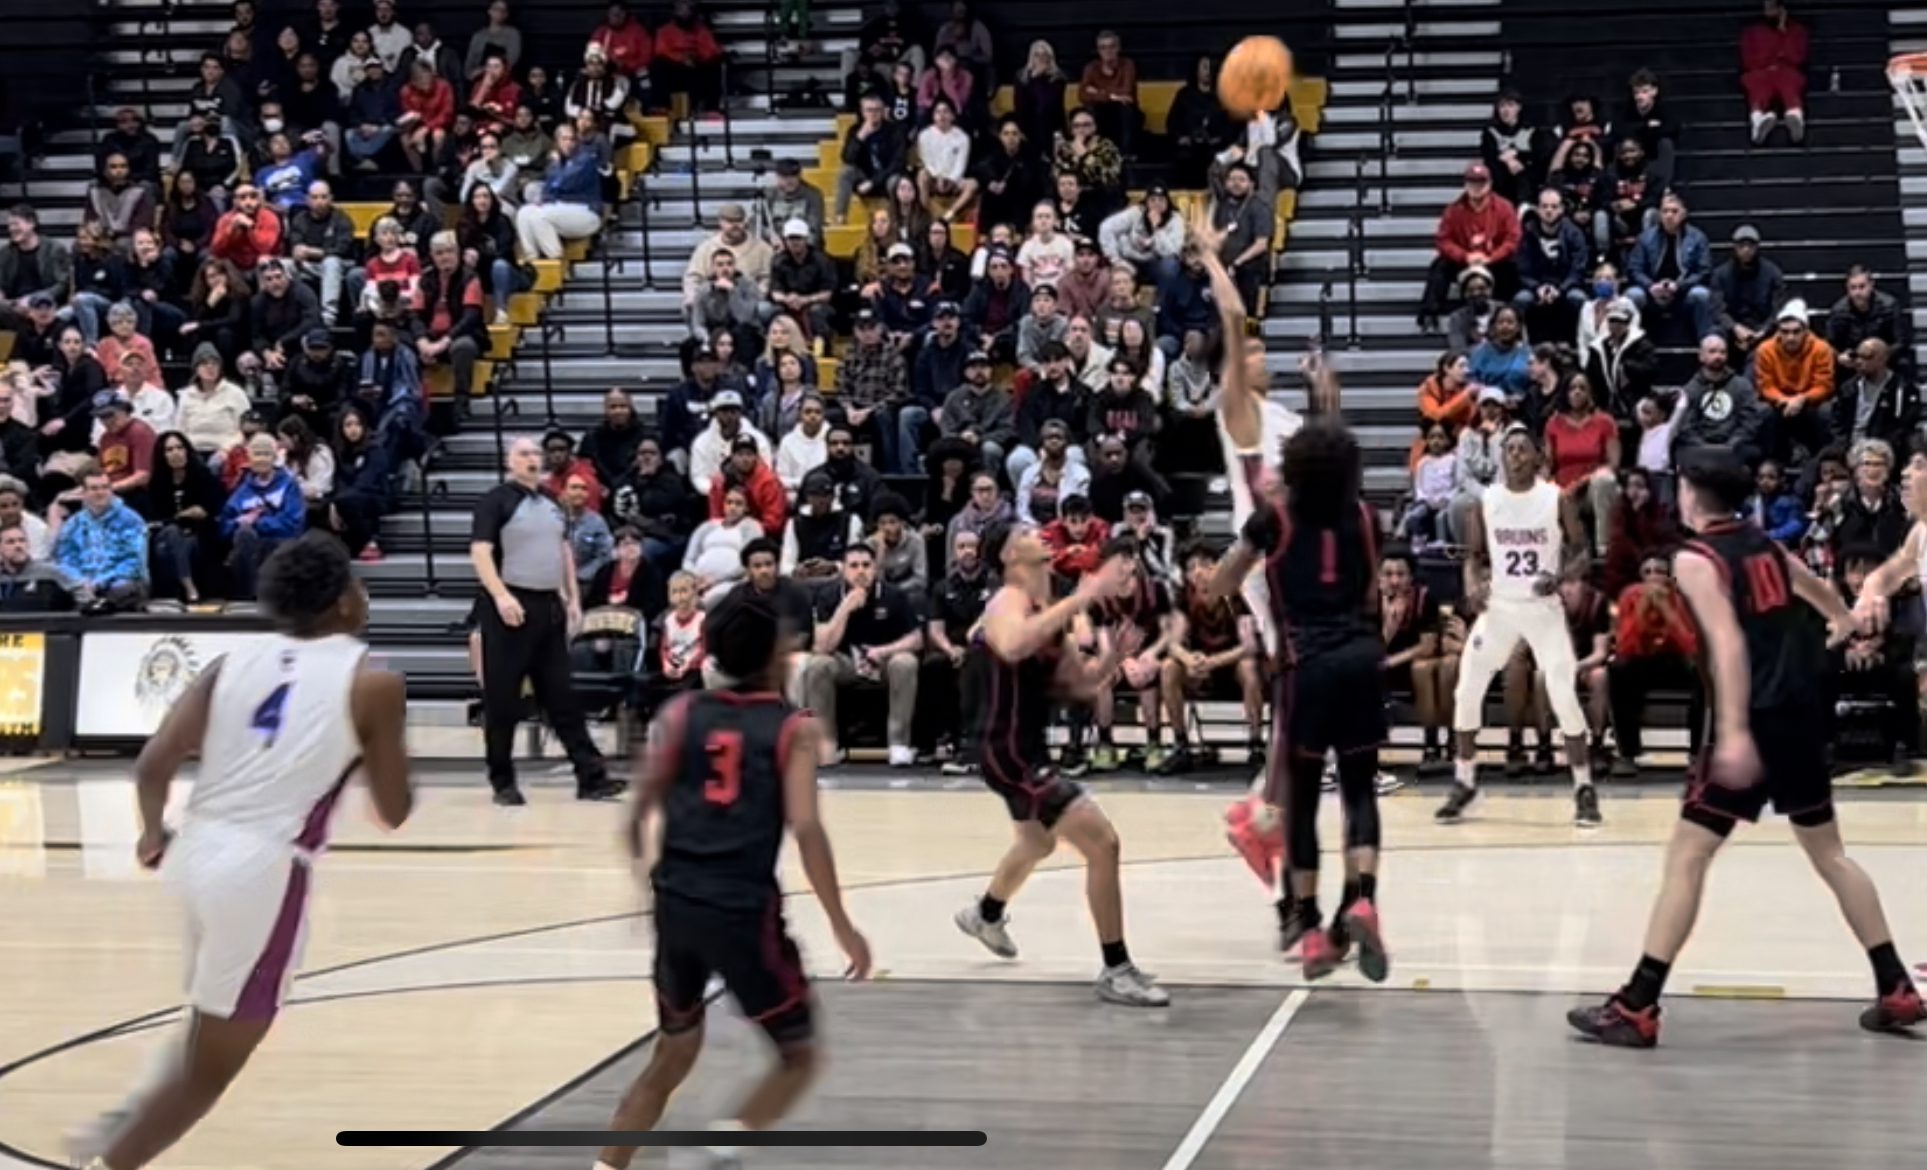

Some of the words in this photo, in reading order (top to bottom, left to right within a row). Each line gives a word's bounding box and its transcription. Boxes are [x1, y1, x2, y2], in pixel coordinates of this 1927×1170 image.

[1320, 528, 1338, 583] 1
[1494, 527, 1548, 546] BRUINS
[1505, 549, 1539, 577] 23
[247, 681, 295, 749] 4
[703, 730, 744, 805] 3
